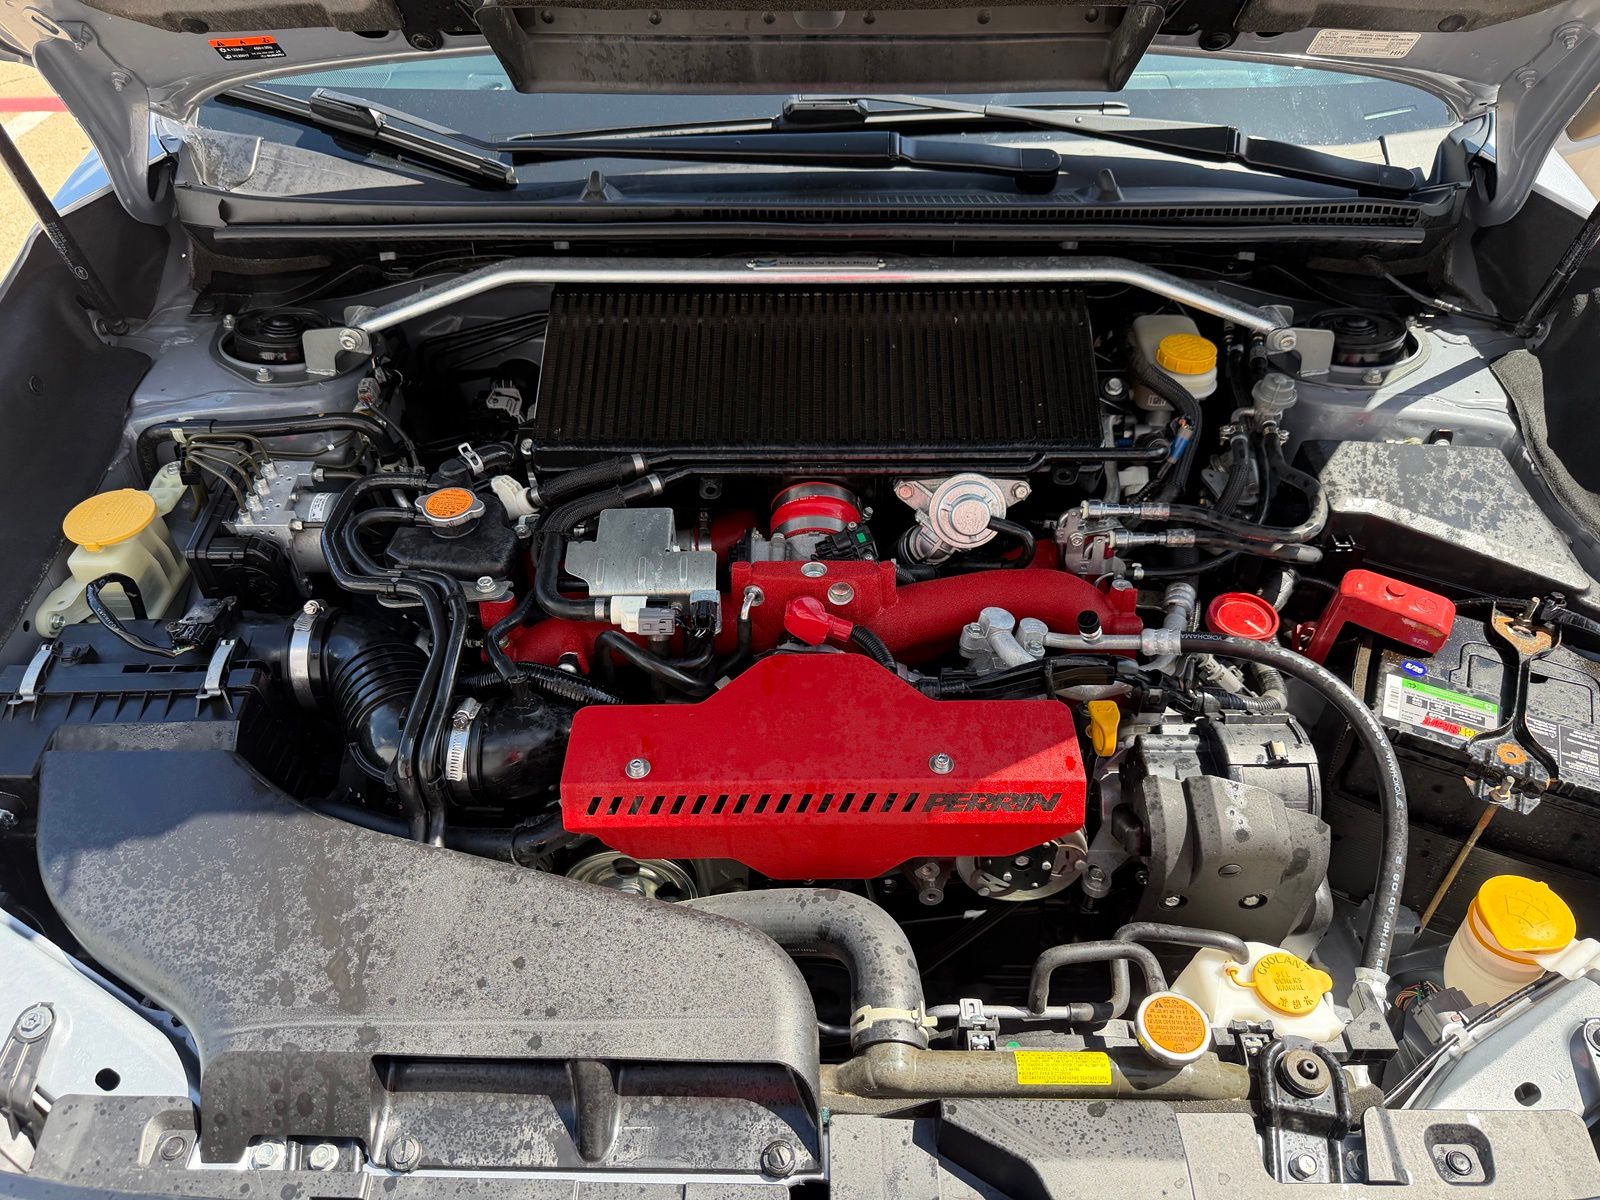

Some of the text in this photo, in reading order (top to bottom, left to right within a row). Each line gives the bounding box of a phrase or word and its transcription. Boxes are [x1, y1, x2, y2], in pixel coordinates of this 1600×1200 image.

[1181, 633, 1222, 641] YOKOHAMA
[1385, 752, 1401, 800] YOKOHAMA
[922, 792, 1062, 812] PERRIN
[1382, 921, 1391, 938] HP
[1388, 896, 1396, 914] AD
[1257, 955, 1310, 976] COOLANT
